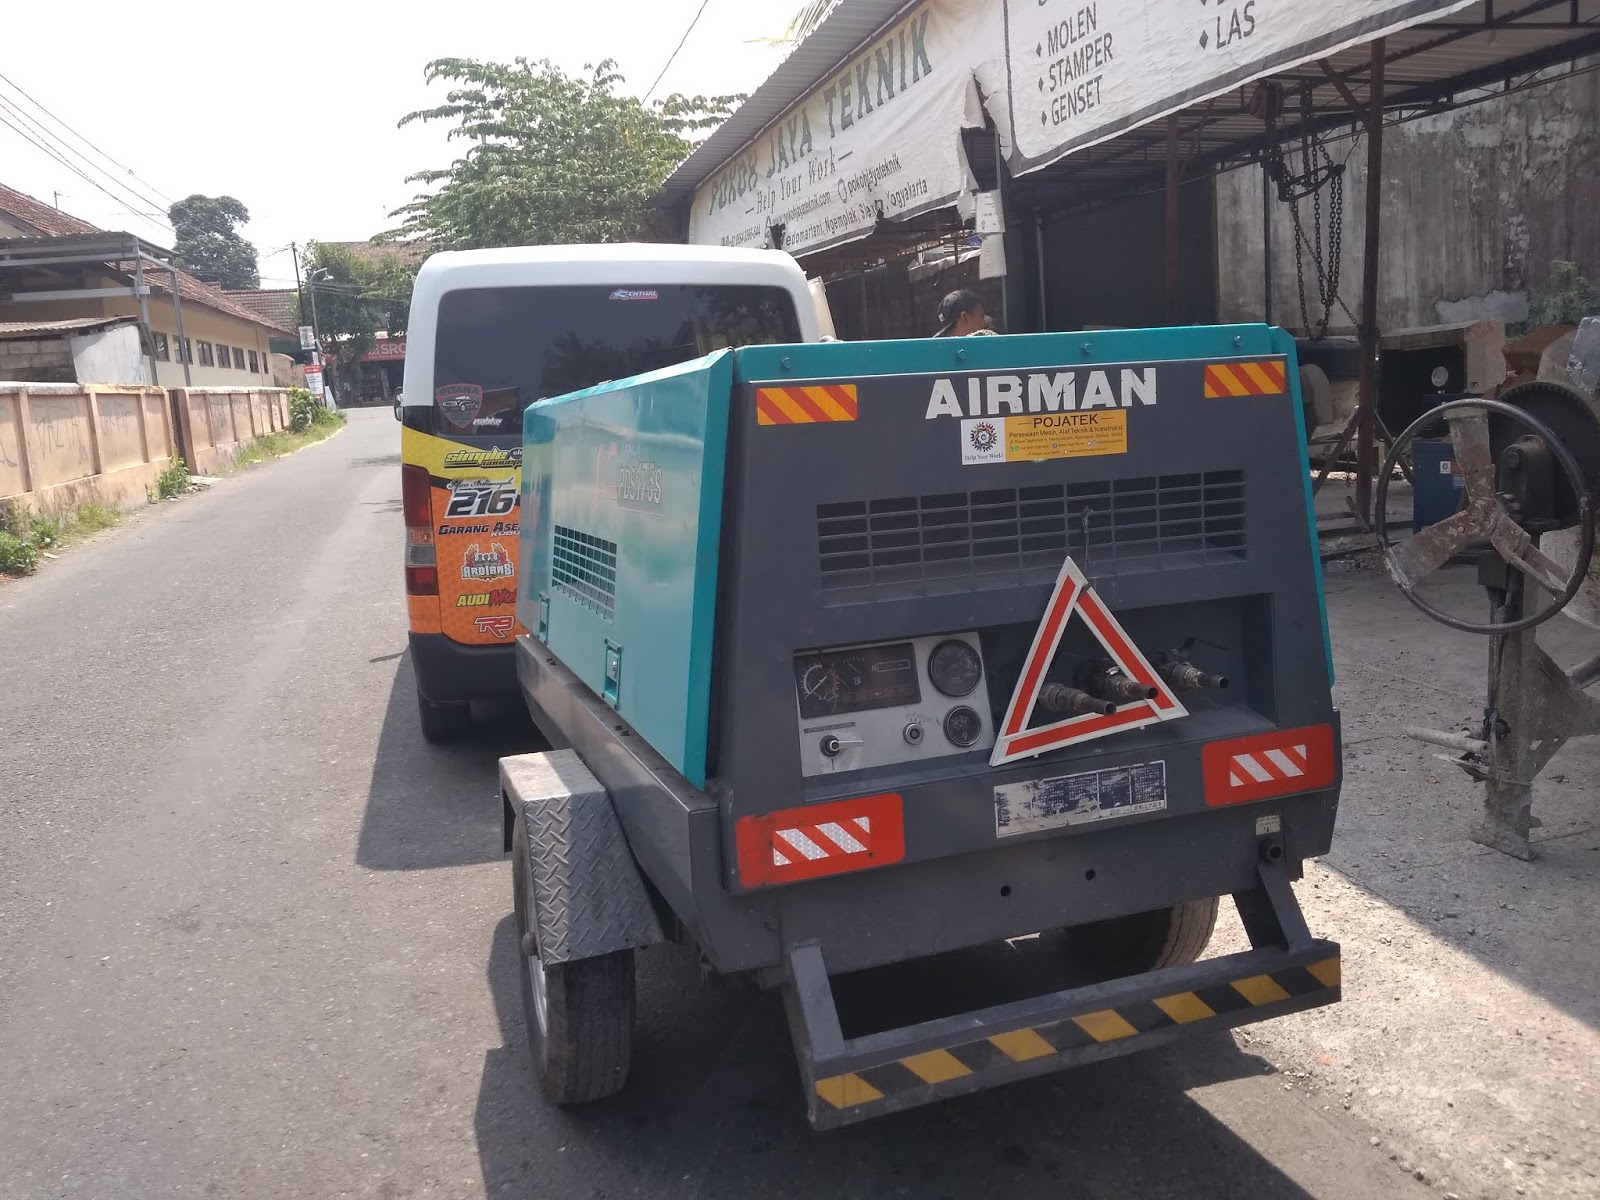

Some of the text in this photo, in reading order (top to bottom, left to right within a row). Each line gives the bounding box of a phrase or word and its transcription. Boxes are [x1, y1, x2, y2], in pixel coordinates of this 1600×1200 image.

[1047, 2, 1098, 57] MOLEN
[1216, 2, 1256, 49] LAS
[1049, 32, 1115, 92] STAMPER
[766, 107, 812, 178] JAYA
[824, 9, 932, 139] TEKNIK
[1051, 74, 1103, 126] GENSET
[756, 147, 837, 214] Help Your Work
[925, 367, 1157, 420] AIRMAN
[1008, 430, 1040, 438] Persewaan
[1071, 426, 1088, 434] Teknik
[1033, 413, 1099, 429] POJATEK
[445, 448, 510, 465] simple
[446, 489, 517, 517] 216
[438, 524, 490, 535] GARANG
[493, 521, 519, 532] ASE
